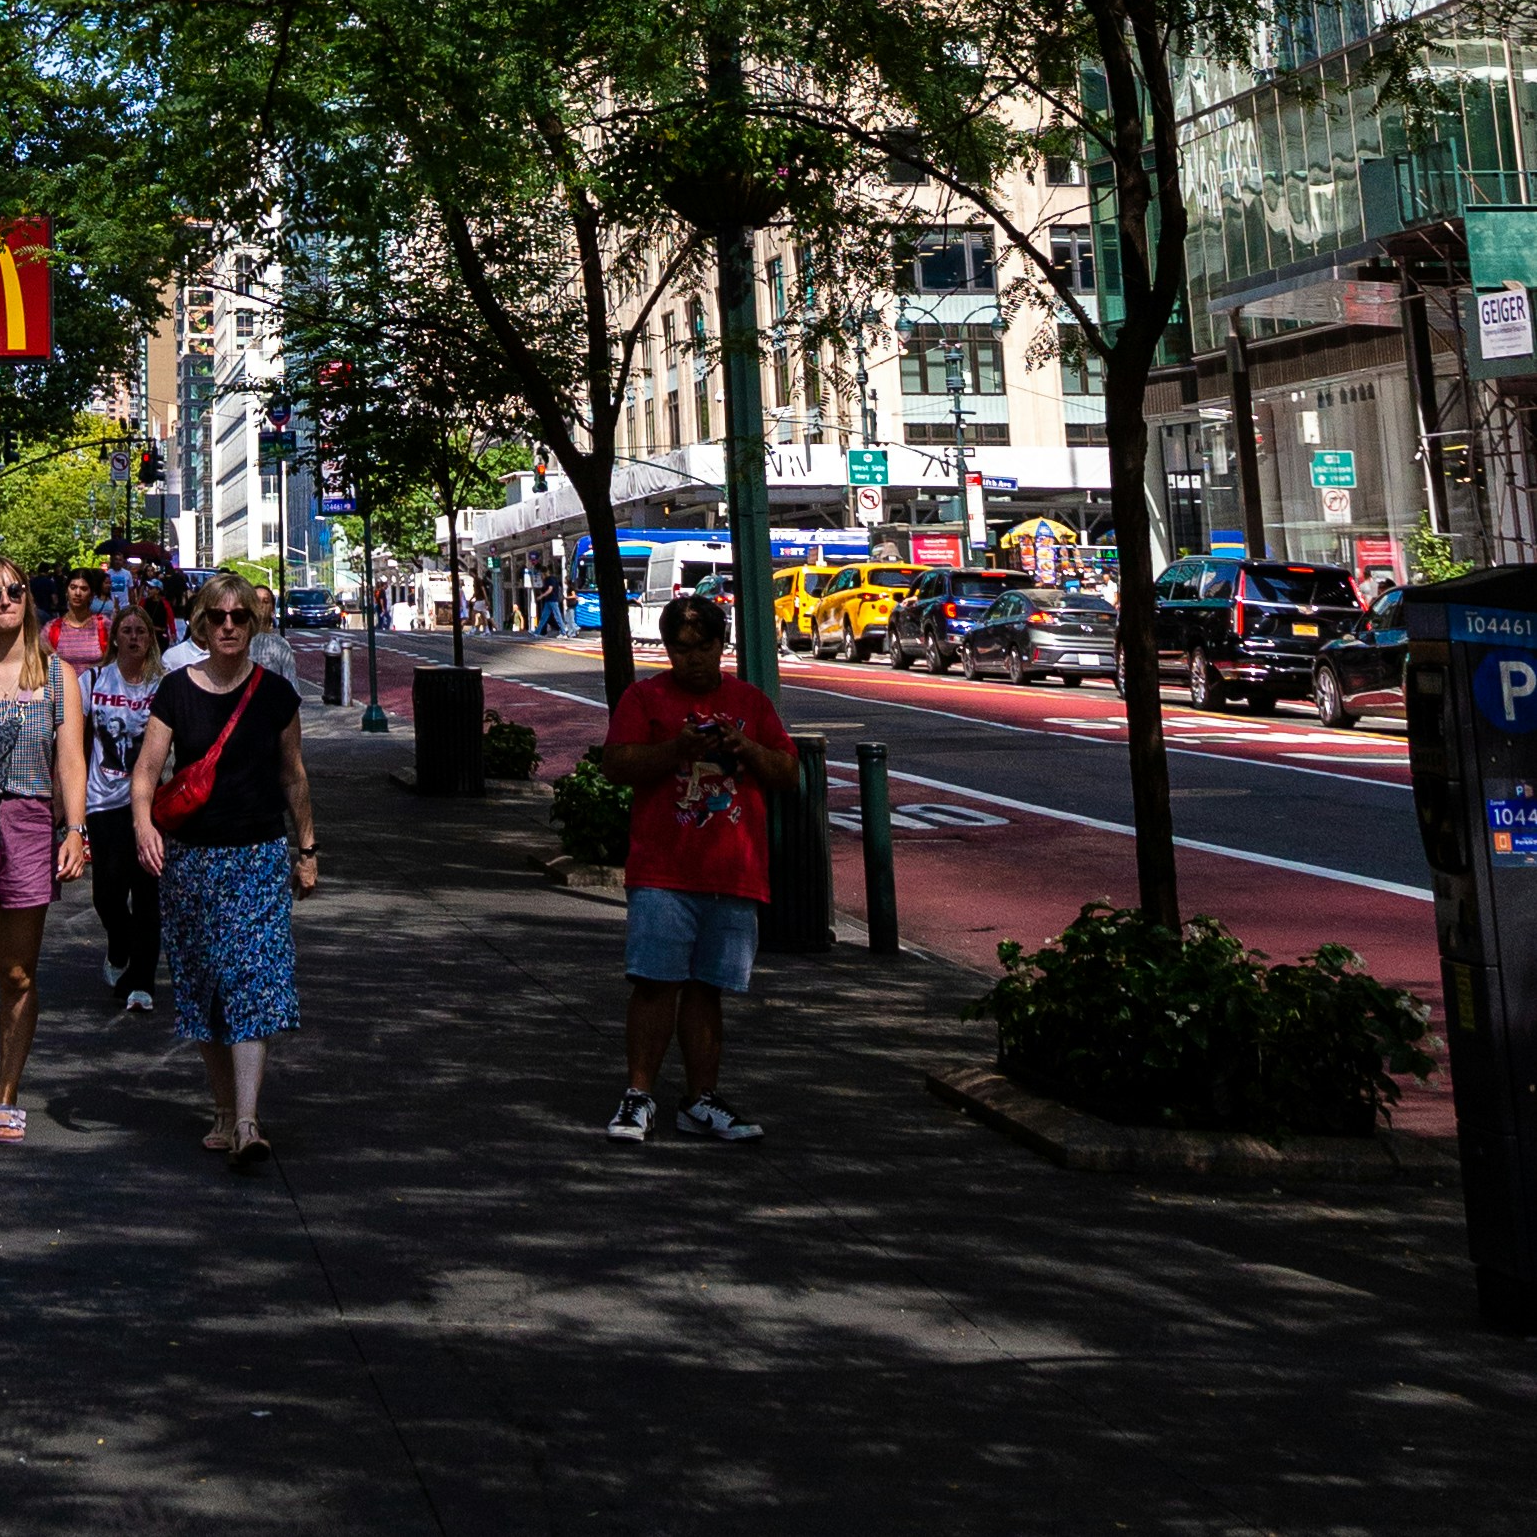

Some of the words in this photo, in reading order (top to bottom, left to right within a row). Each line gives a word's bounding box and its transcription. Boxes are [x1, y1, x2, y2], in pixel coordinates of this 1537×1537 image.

[1481, 295, 1527, 325] GEIGER
[1466, 616, 1532, 636] 104461
[93, 692, 127, 708] THE
[1499, 660, 1537, 721] P
